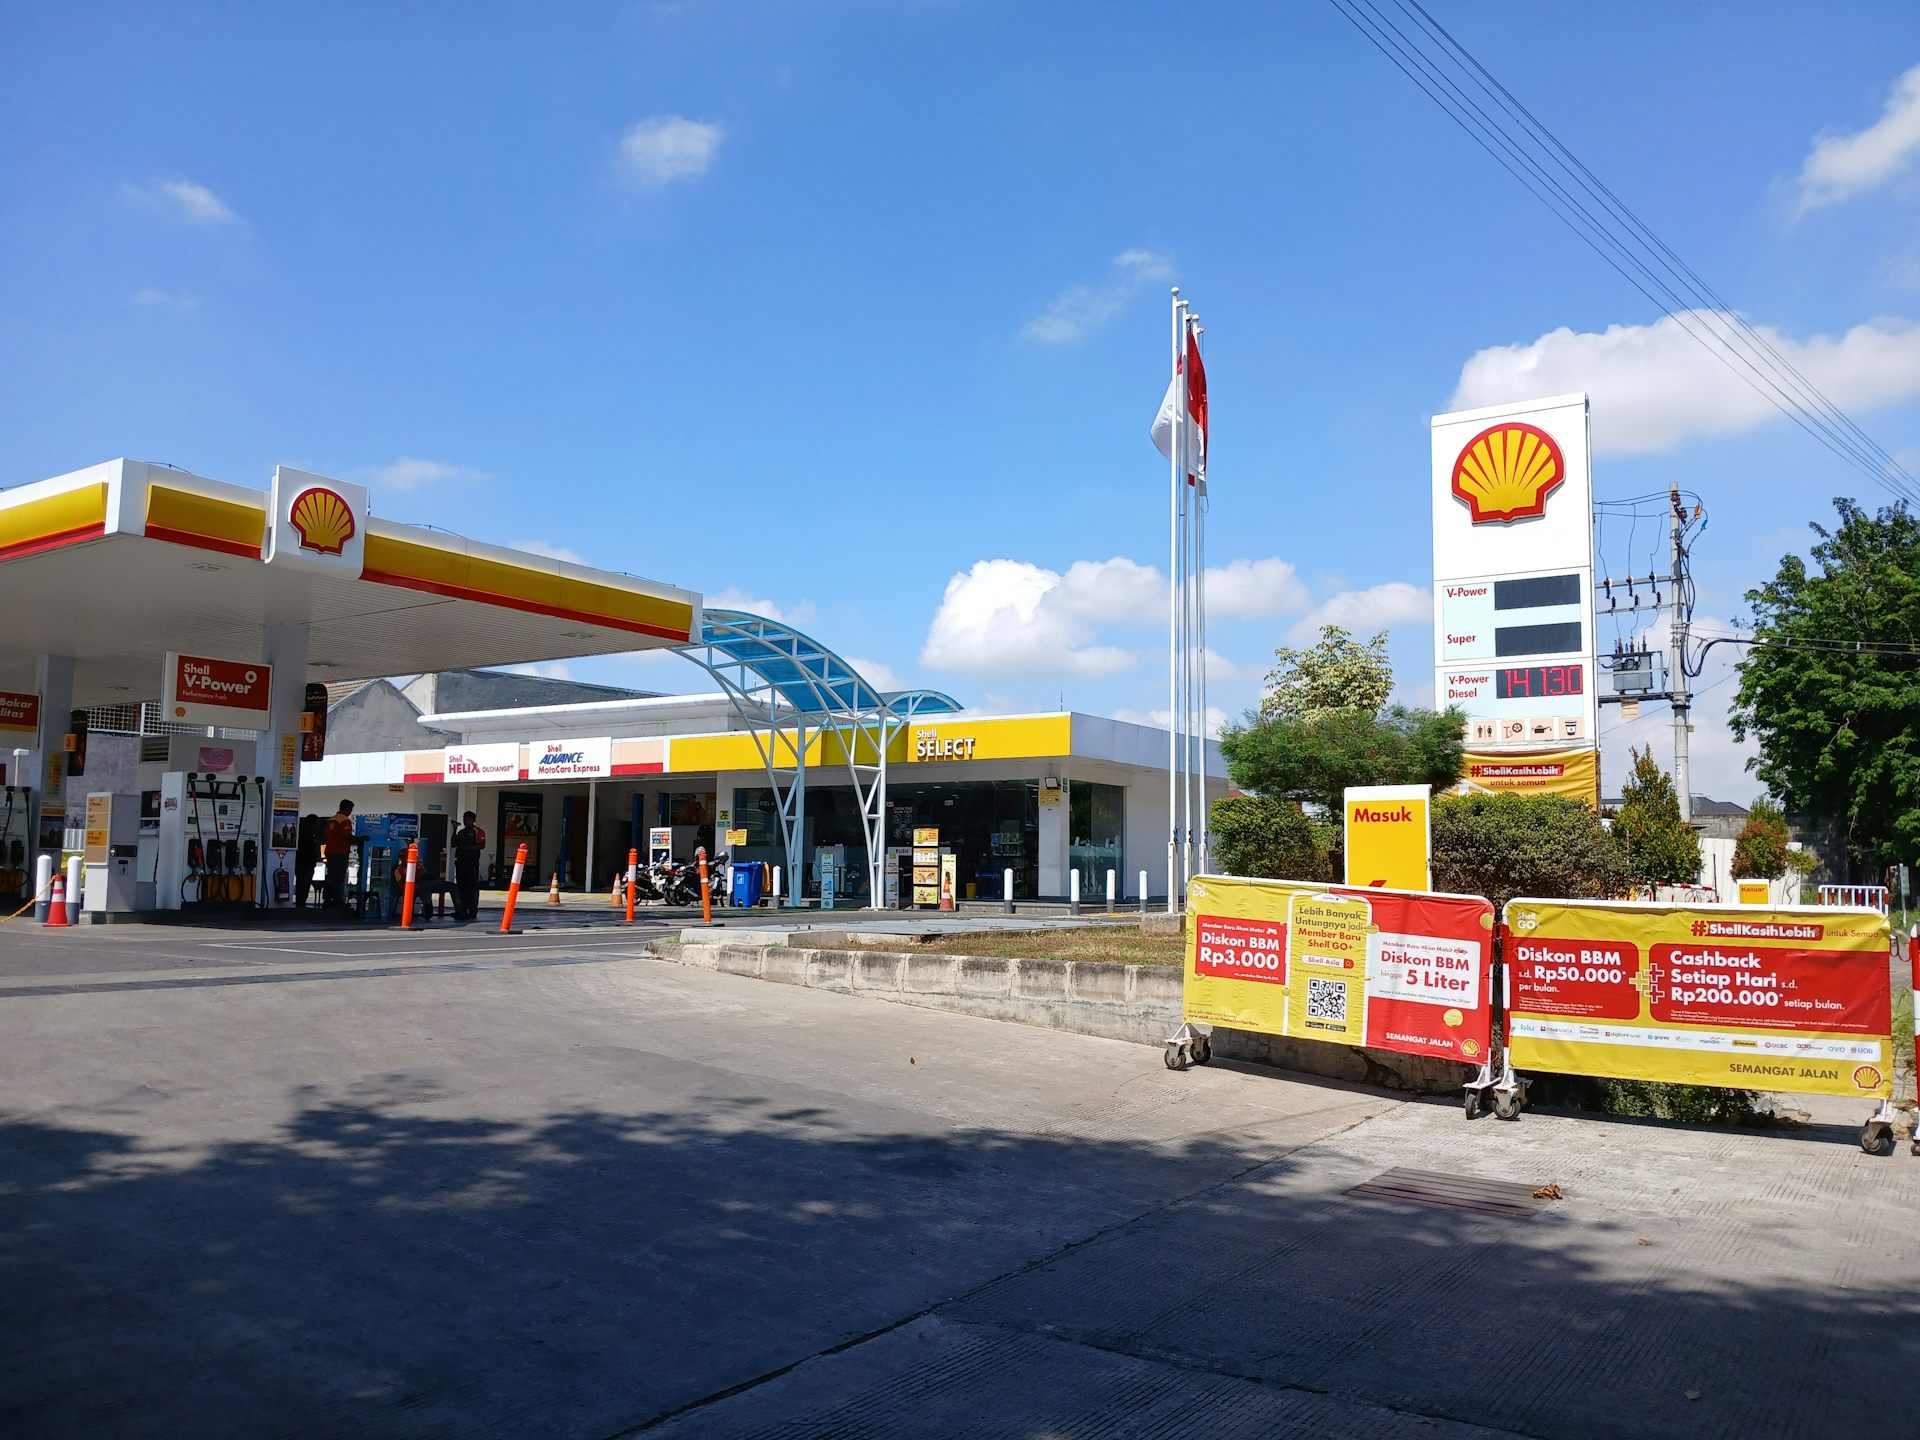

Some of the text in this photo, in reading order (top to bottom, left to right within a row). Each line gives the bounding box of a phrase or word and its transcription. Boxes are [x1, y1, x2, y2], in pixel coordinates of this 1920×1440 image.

[1447, 587, 1487, 598] V-Power
[1447, 634, 1476, 645] Super
[184, 663, 210, 675] Shell
[184, 674, 251, 694] V-Power
[1449, 675, 1489, 685] V-Power
[183, 690, 214, 699] Performance
[1448, 687, 1477, 698] Diesel
[917, 728, 937, 739] Shell
[547, 744, 562, 753] Shell
[917, 738, 975, 757] SELECT
[449, 755, 463, 763] Shell
[539, 752, 584, 765] ADVANCE
[449, 759, 480, 774] HELIX
[538, 764, 600, 774] MotoCare Express
[1354, 806, 1413, 823] Masuk
[1299, 907, 1362, 920] Lebih Banyak
[1517, 912, 1536, 920] Shell
[1296, 917, 1363, 932] Untungnya jadi
[1298, 928, 1361, 941] Member Baru
[1826, 930, 1849, 938] untuk
[1850, 929, 1879, 938] Semua
[1201, 932, 1280, 951] Diskon BBM
[1308, 939, 1354, 951] Shell GO+
[1200, 947, 1279, 970] Rp3.000
[1381, 950, 1470, 971] Diskon BBM
[1517, 947, 1621, 966] Diskon BBM
[1670, 951, 1761, 969] Cashback
[1381, 969, 1470, 991] hingga 5 Liter
[1518, 969, 1532, 979] s.d.
[1670, 969, 1798, 990] Setiap Hari s.d.
[1519, 982, 1560, 992] per bulan.
[1784, 999, 1813, 1011] setiap
[1815, 999, 1845, 1011] bulan.
[1385, 1032, 1453, 1048] SEMANGAT JALAN
[1729, 1063, 1839, 1080] SEMANGAT JALAN
